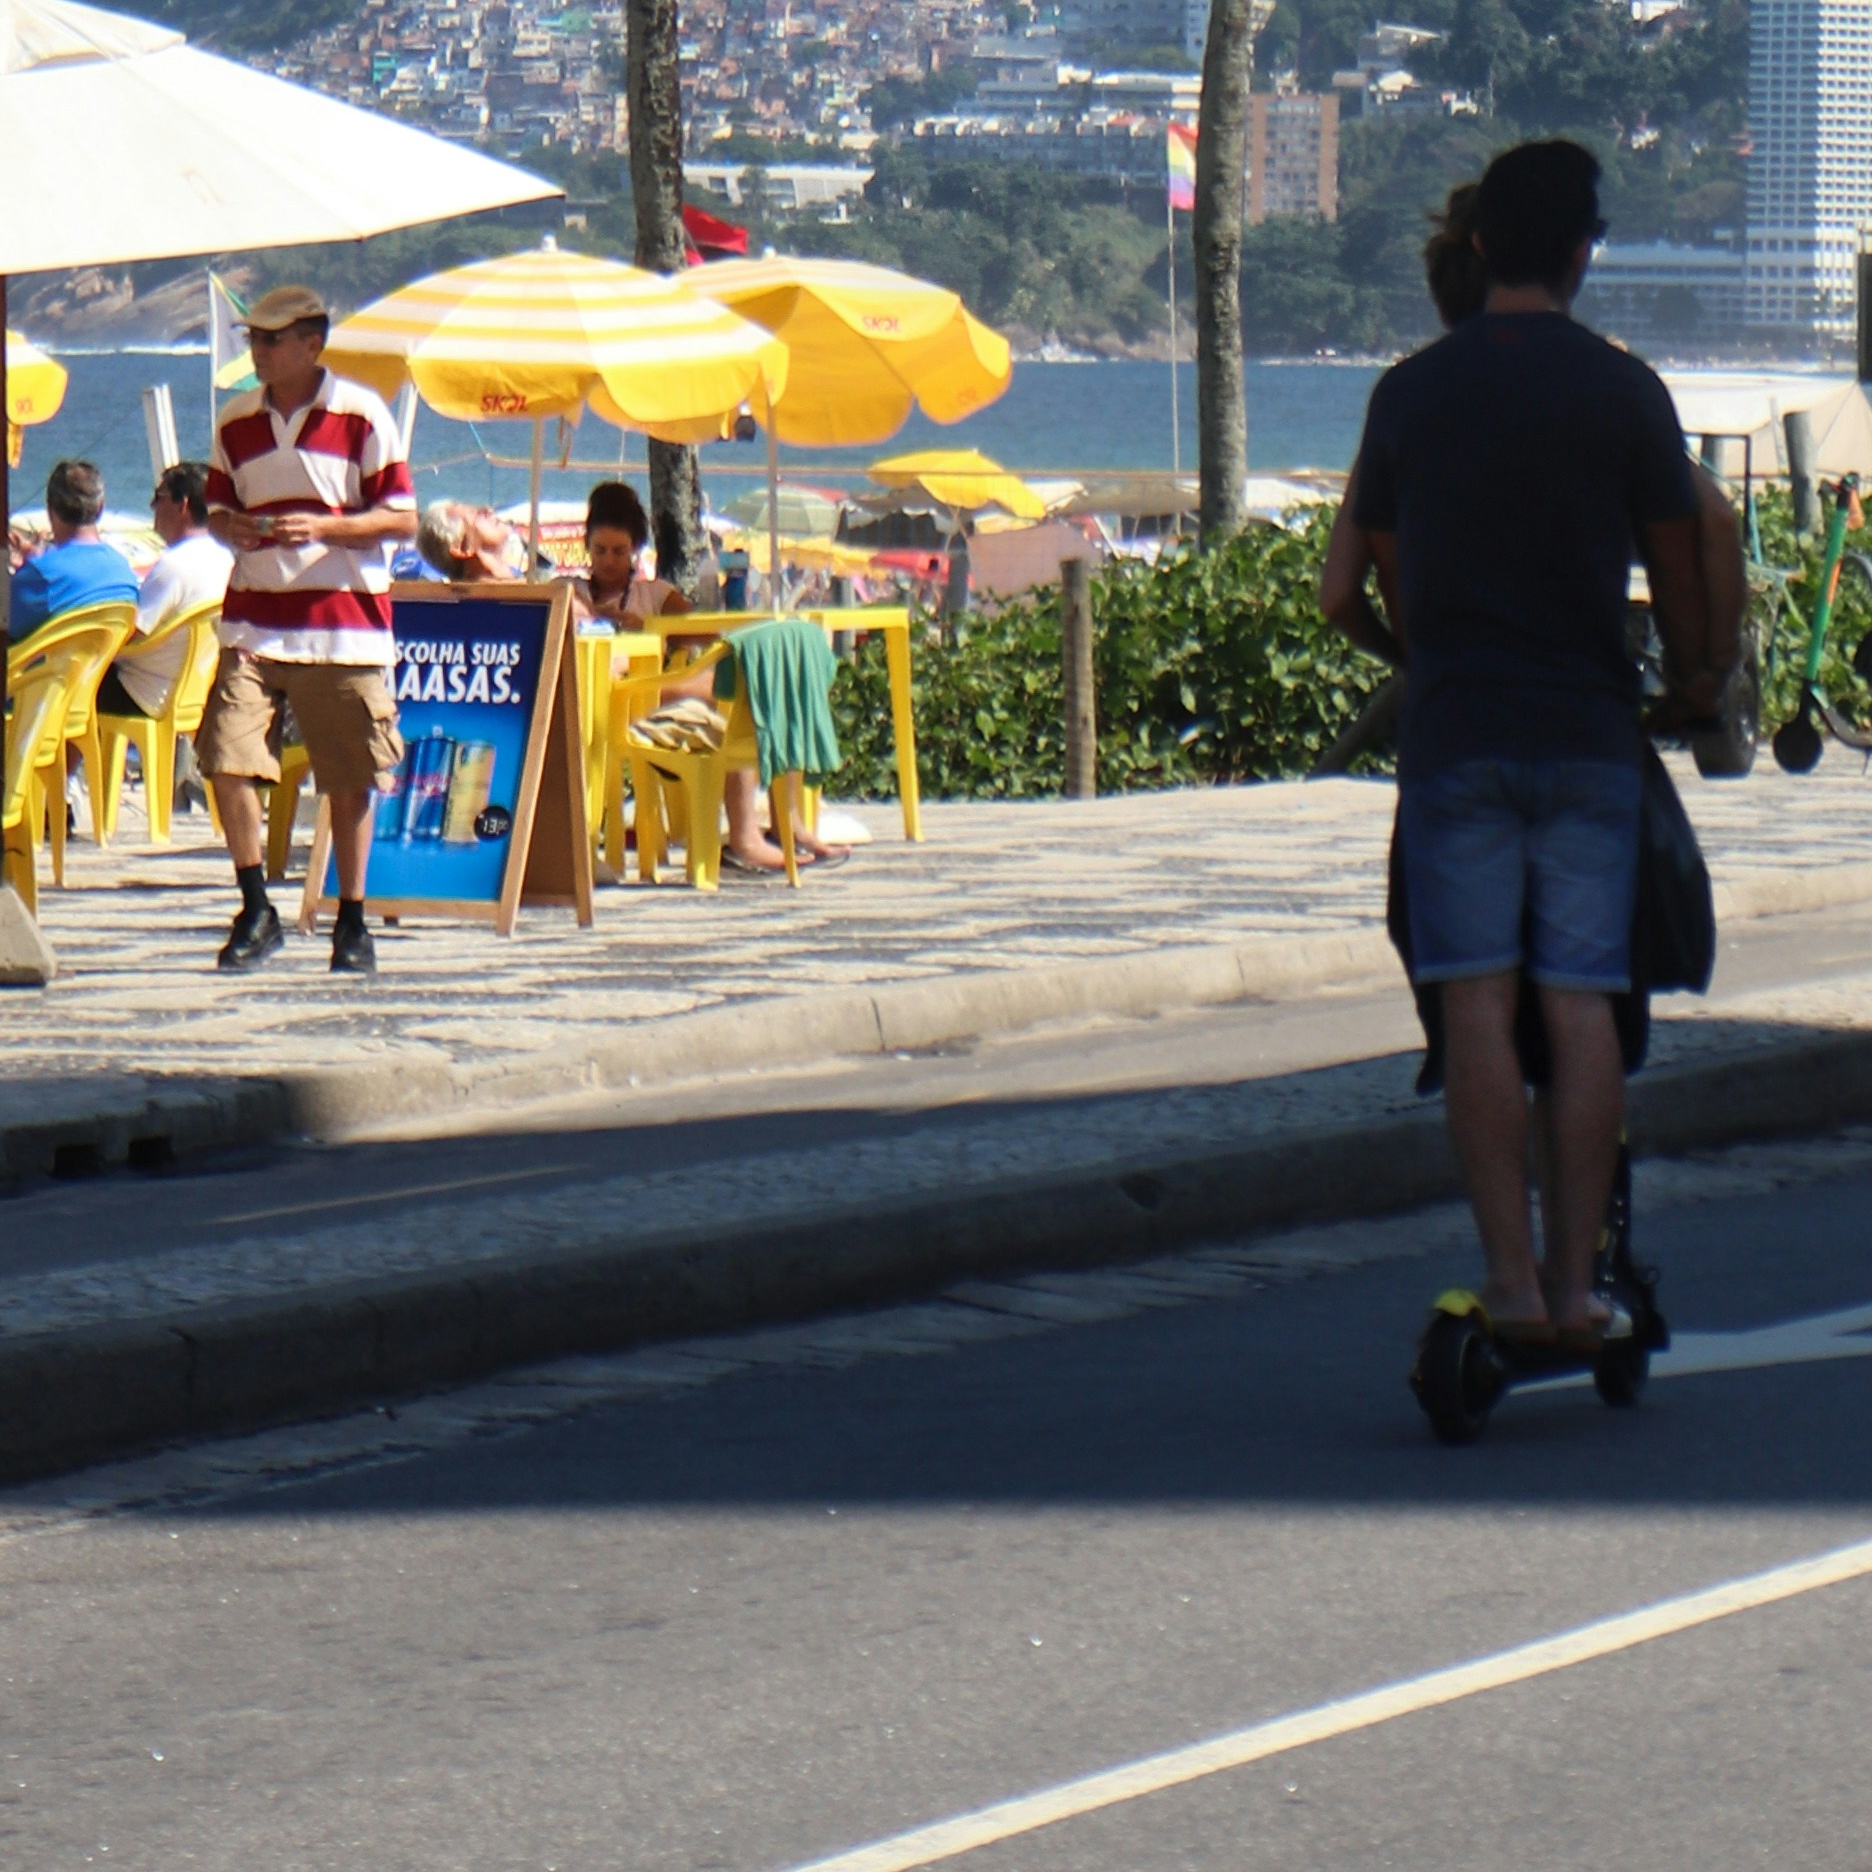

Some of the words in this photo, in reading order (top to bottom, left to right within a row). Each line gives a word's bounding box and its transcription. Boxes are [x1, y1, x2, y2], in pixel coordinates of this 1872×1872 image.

[481, 393, 527, 412] SKOL
[395, 641, 465, 664] SCOLHA
[471, 642, 521, 665] SUAS
